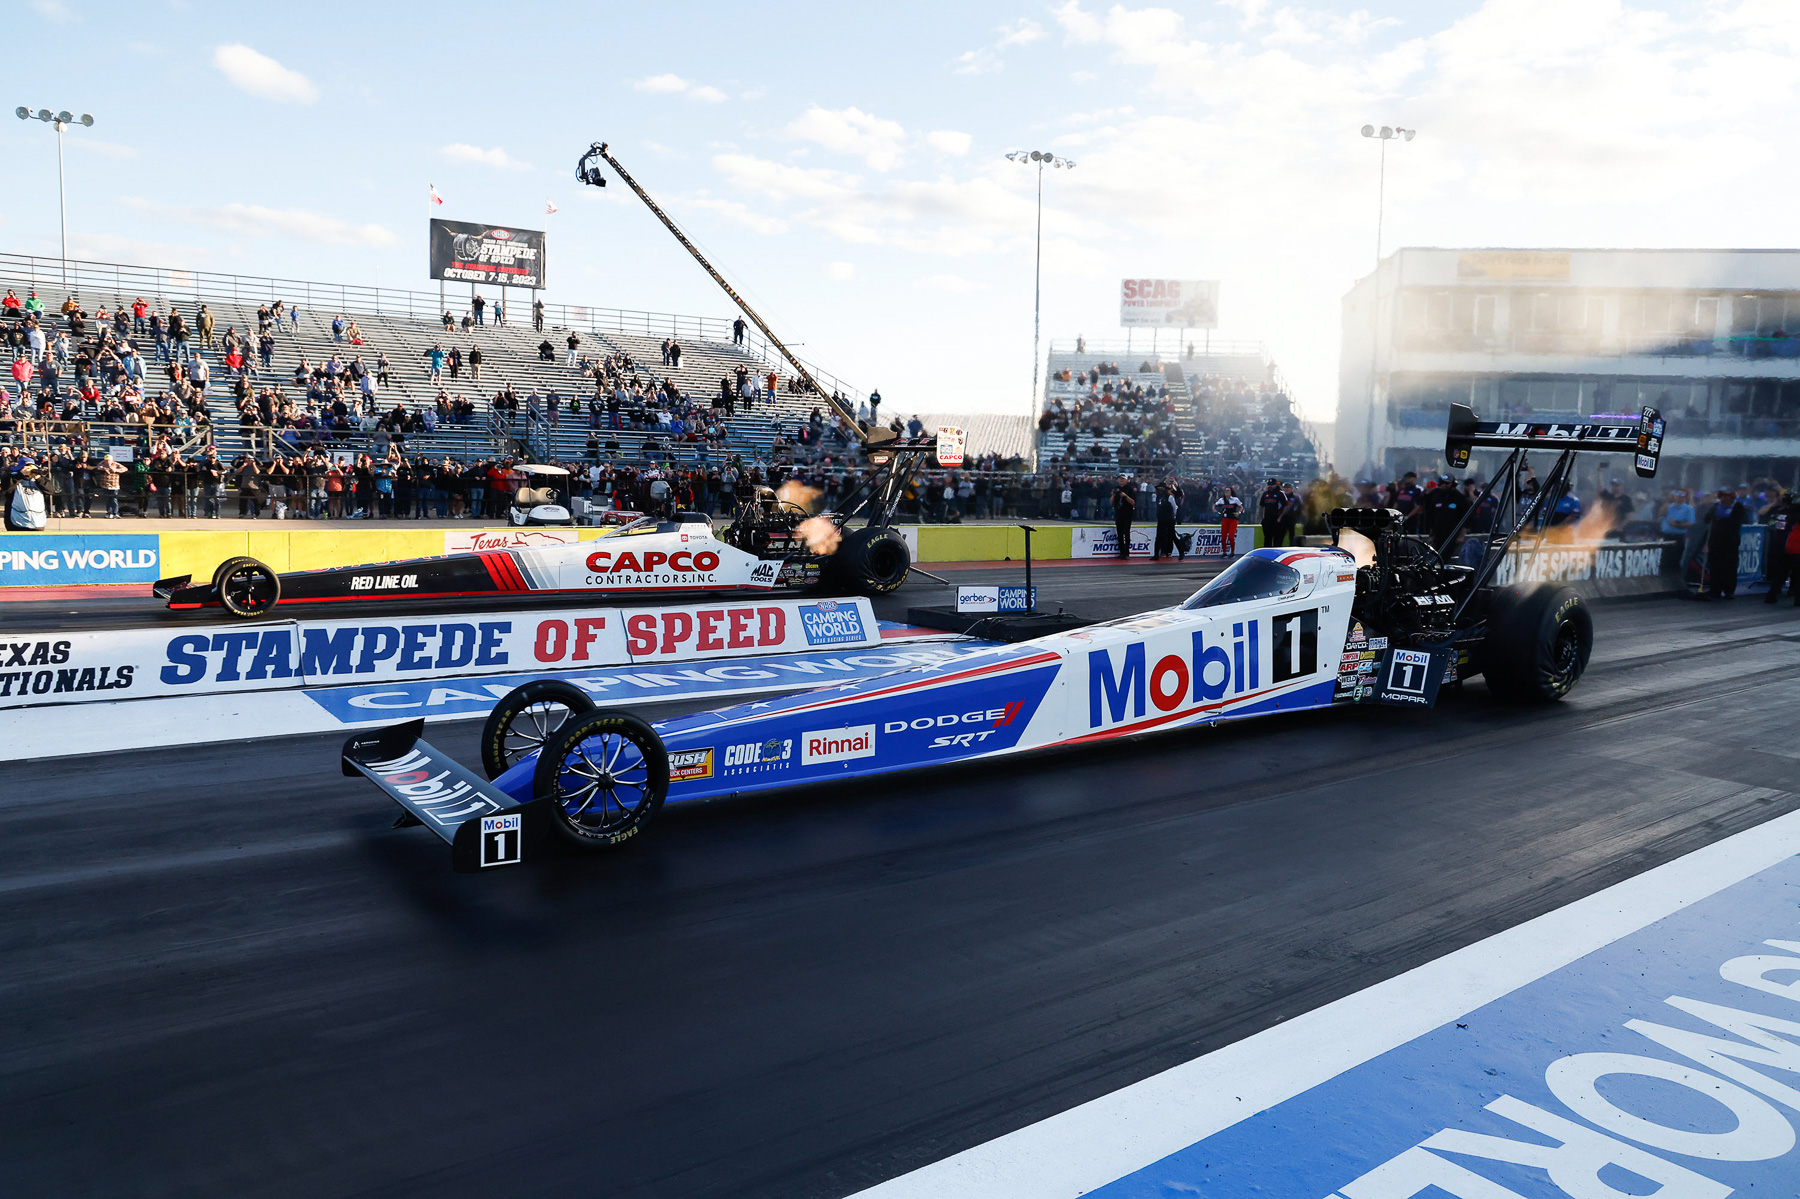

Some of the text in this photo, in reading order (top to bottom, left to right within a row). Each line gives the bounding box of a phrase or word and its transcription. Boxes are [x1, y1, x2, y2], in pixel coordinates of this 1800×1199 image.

[479, 254, 515, 265] OF SPEED
[480, 244, 537, 260] STAMPEDE
[444, 268, 486, 281] OCTOBER
[512, 274, 536, 286] 2023
[1124, 280, 1181, 298] SCAG
[470, 533, 508, 551] Texas
[867, 534, 888, 548] EAGLE
[1102, 530, 1119, 543] Texa
[1093, 543, 1150, 552] MOTOPLEX
[0, 550, 156, 570] PING WORLD
[586, 551, 720, 573] CAPCO
[1550, 552, 1592, 580] SPEED
[1595, 550, 1622, 579] WAS
[751, 564, 774, 577] MAC
[351, 574, 418, 590] RED LINE OIL
[960, 593, 986, 604] gerber
[804, 610, 857, 624] CAMPING
[1555, 597, 1578, 623] EAGLE
[807, 622, 860, 638] WORLD
[160, 606, 786, 685] STAMPEDE OF SPEED
[1342, 652, 1359, 660] SIMPSON
[1395, 652, 1428, 664] Mobil
[1088, 620, 1259, 728] Mobil
[1286, 616, 1301, 674] 1
[1340, 662, 1358, 672] ARP
[1402, 665, 1414, 687] 1
[1381, 692, 1426, 704] MOPAR
[884, 708, 1006, 734] DODGE
[564, 718, 624, 748] GOODYEAR
[928, 730, 996, 749] SRT
[724, 739, 792, 766] CODE 3
[809, 732, 870, 756] Rinnai
[680, 768, 702, 776] CENTERS
[724, 762, 790, 776] ASSOCIATES
[365, 749, 486, 818] Mobil 1
[484, 817, 518, 830] Mobil
[610, 826, 638, 844] EAGLE
[494, 833, 505, 860] 1
[1325, 995, 1800, 1199] WORL
